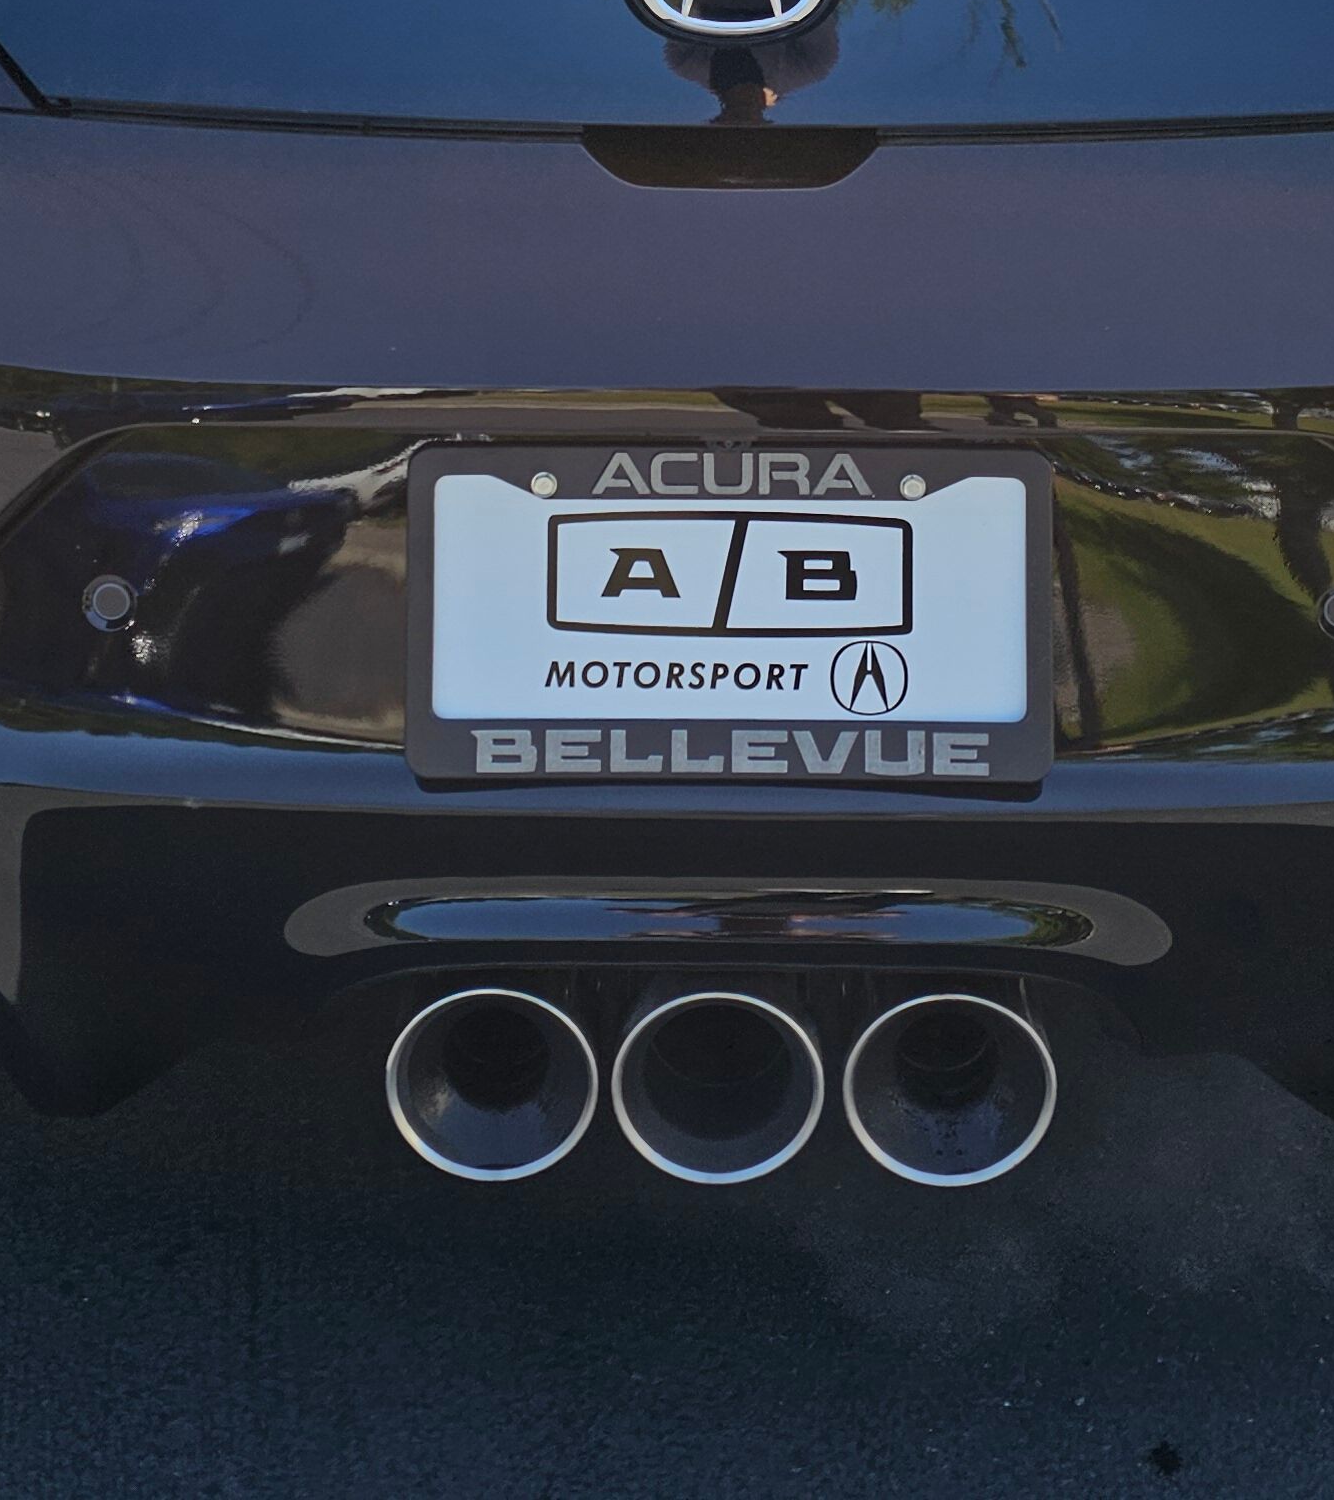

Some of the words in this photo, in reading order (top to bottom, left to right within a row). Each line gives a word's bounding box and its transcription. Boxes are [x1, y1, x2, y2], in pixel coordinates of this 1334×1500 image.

[591, 452, 873, 496] ACURA
[601, 547, 681, 599] A
[777, 550, 857, 600] B
[544, 660, 809, 691] MOTORSPORT
[469, 728, 990, 776] BELLEVUE
